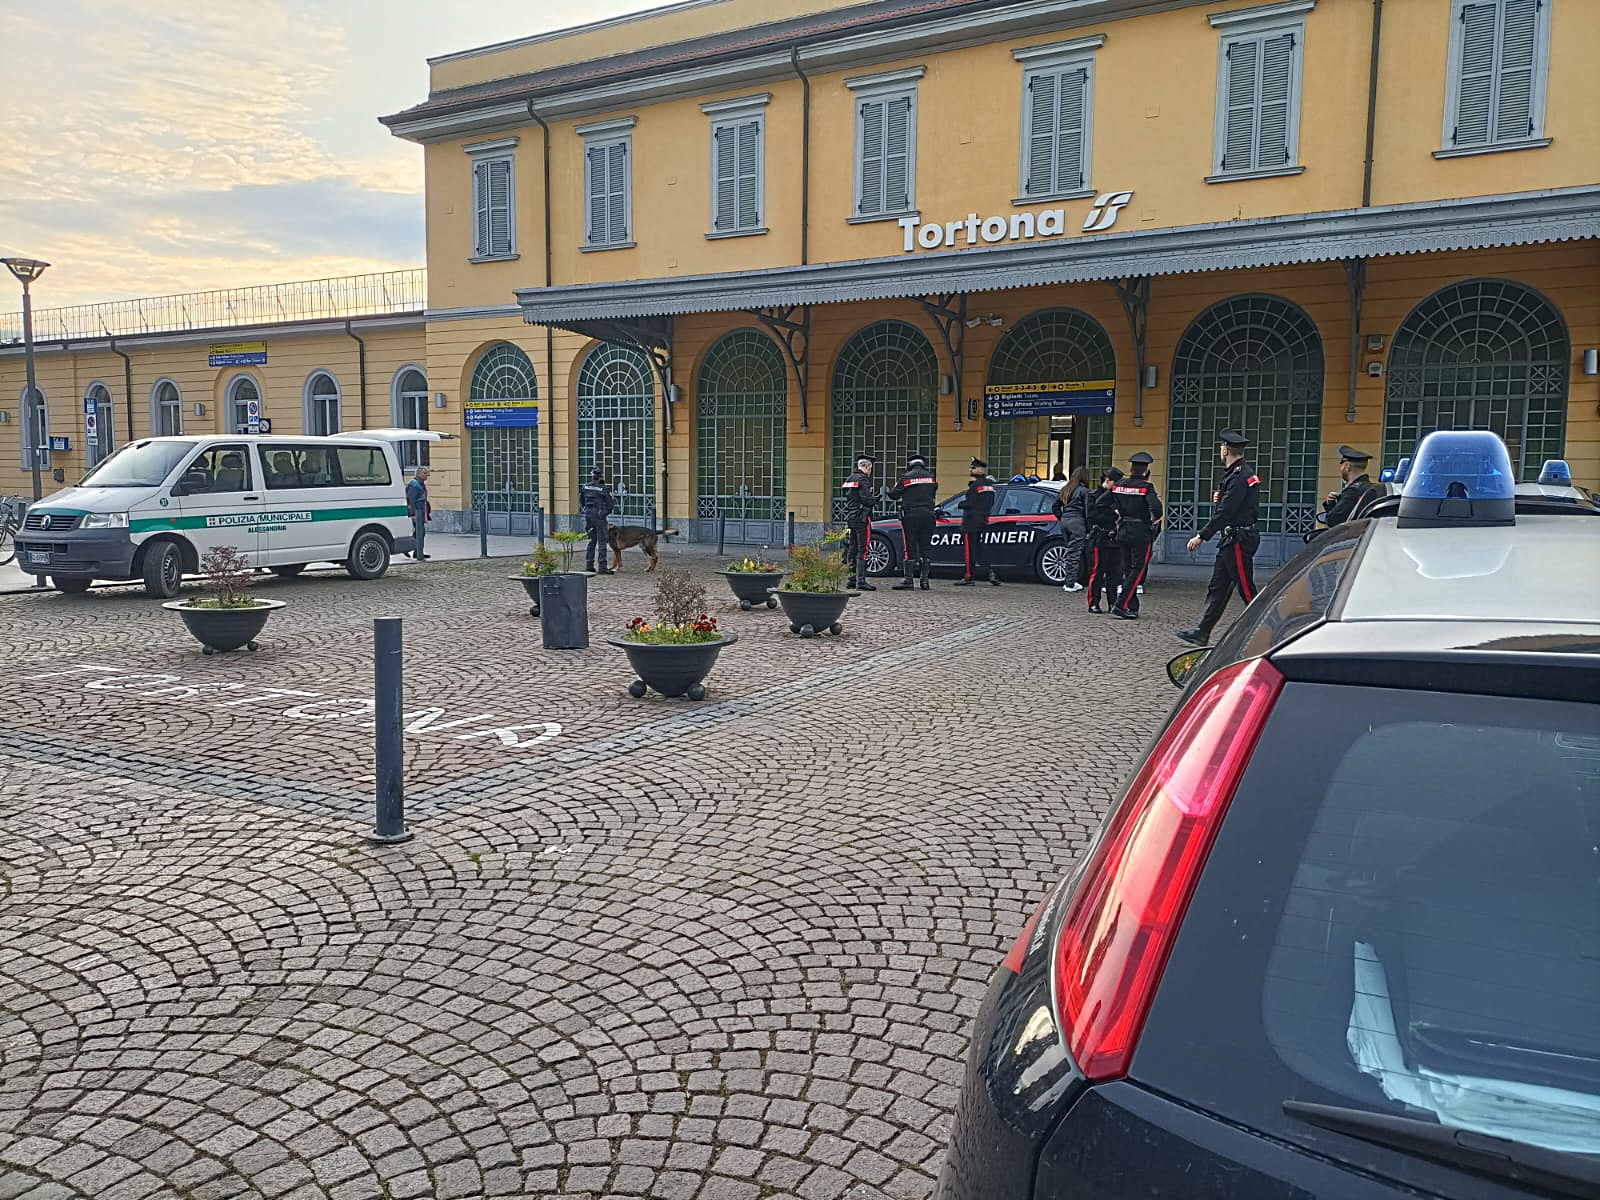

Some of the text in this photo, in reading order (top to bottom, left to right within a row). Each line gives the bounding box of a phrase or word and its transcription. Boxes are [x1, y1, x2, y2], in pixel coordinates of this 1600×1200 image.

[898, 208, 1065, 252] Tortona
[218, 512, 312, 525] POLIZIA MUNICIPALE
[930, 530, 1035, 546] CARINIERI
